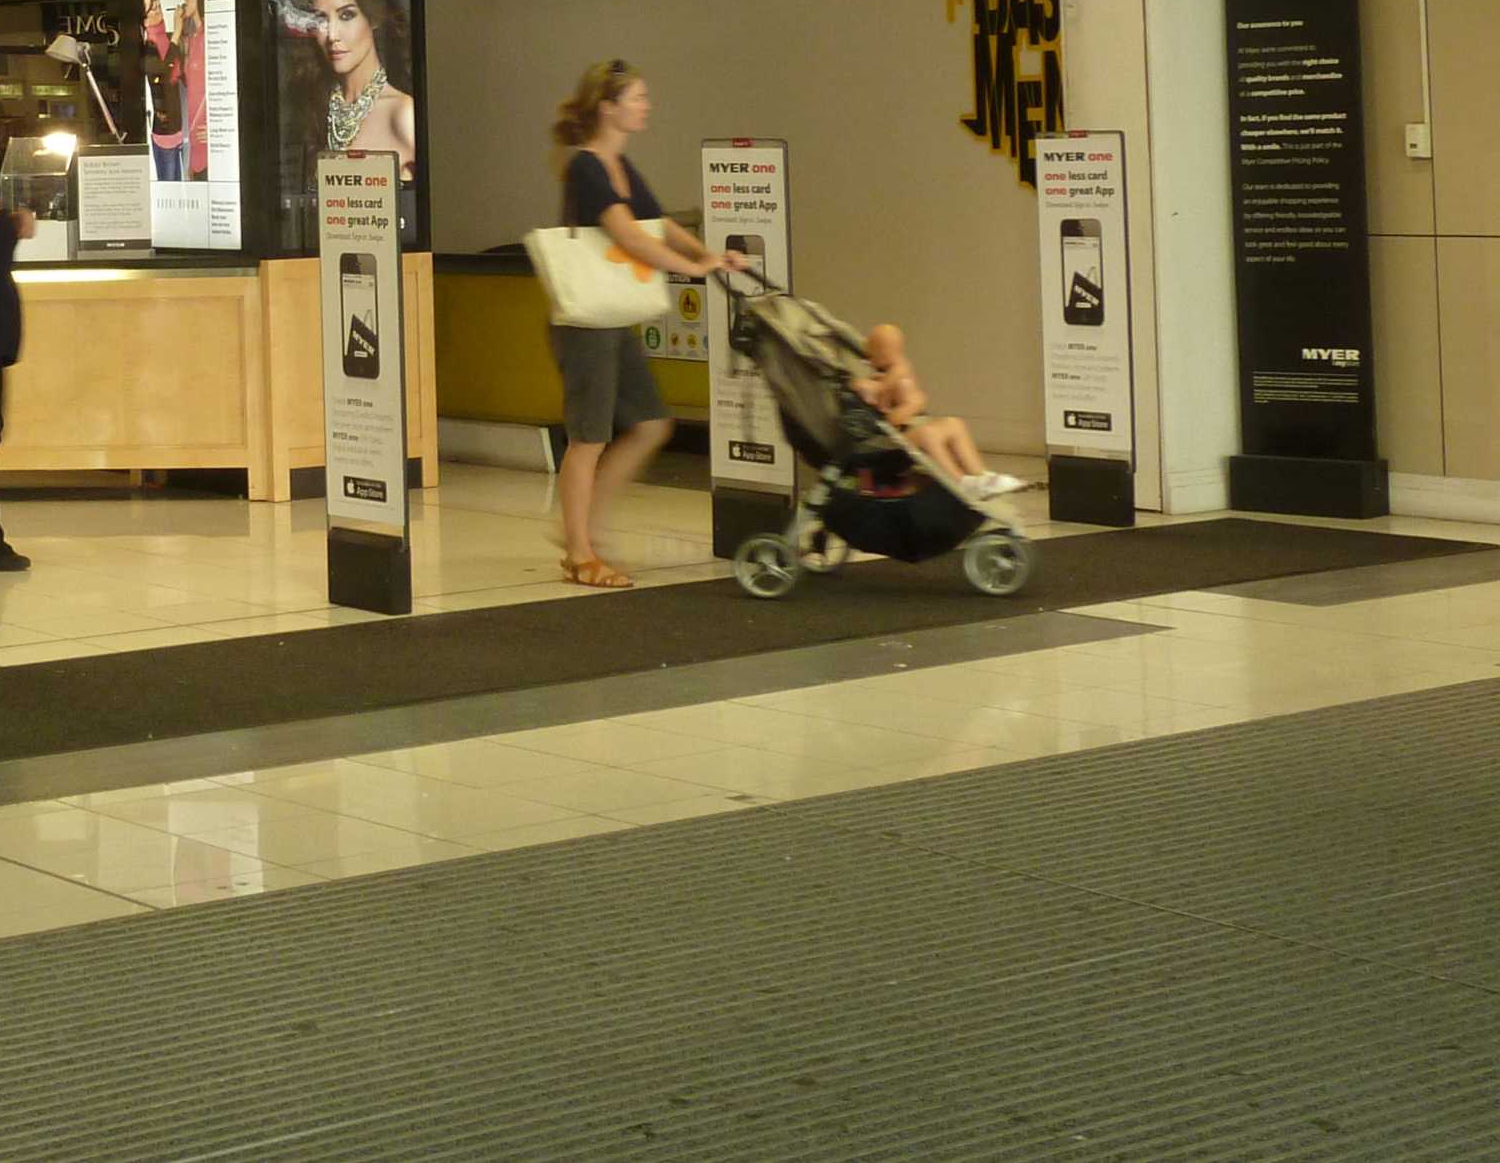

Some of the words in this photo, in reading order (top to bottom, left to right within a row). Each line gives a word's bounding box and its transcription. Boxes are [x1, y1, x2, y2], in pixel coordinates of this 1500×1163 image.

[1044, 152, 1085, 162] MYER
[1088, 152, 1113, 162] one
[709, 162, 749, 173] MYER
[751, 163, 776, 174] one
[325, 175, 362, 186] MYER
[365, 176, 388, 187] one
[1044, 172, 1066, 181] one
[1068, 170, 1085, 181] less
[1087, 169, 1108, 181] card
[711, 184, 731, 193] one
[732, 182, 749, 194] less
[751, 182, 771, 194] card
[1045, 187, 1068, 196] one
[1069, 186, 1093, 197] great
[1095, 185, 1115, 197] App
[326, 198, 345, 208] one
[347, 196, 363, 209] less
[364, 197, 383, 209] card
[711, 200, 732, 210] one
[733, 199, 757, 212] great
[758, 199, 777, 213] App
[326, 216, 346, 226] one
[347, 215, 369, 228] great
[370, 214, 389, 230] App
[1301, 348, 1361, 361] MYER
